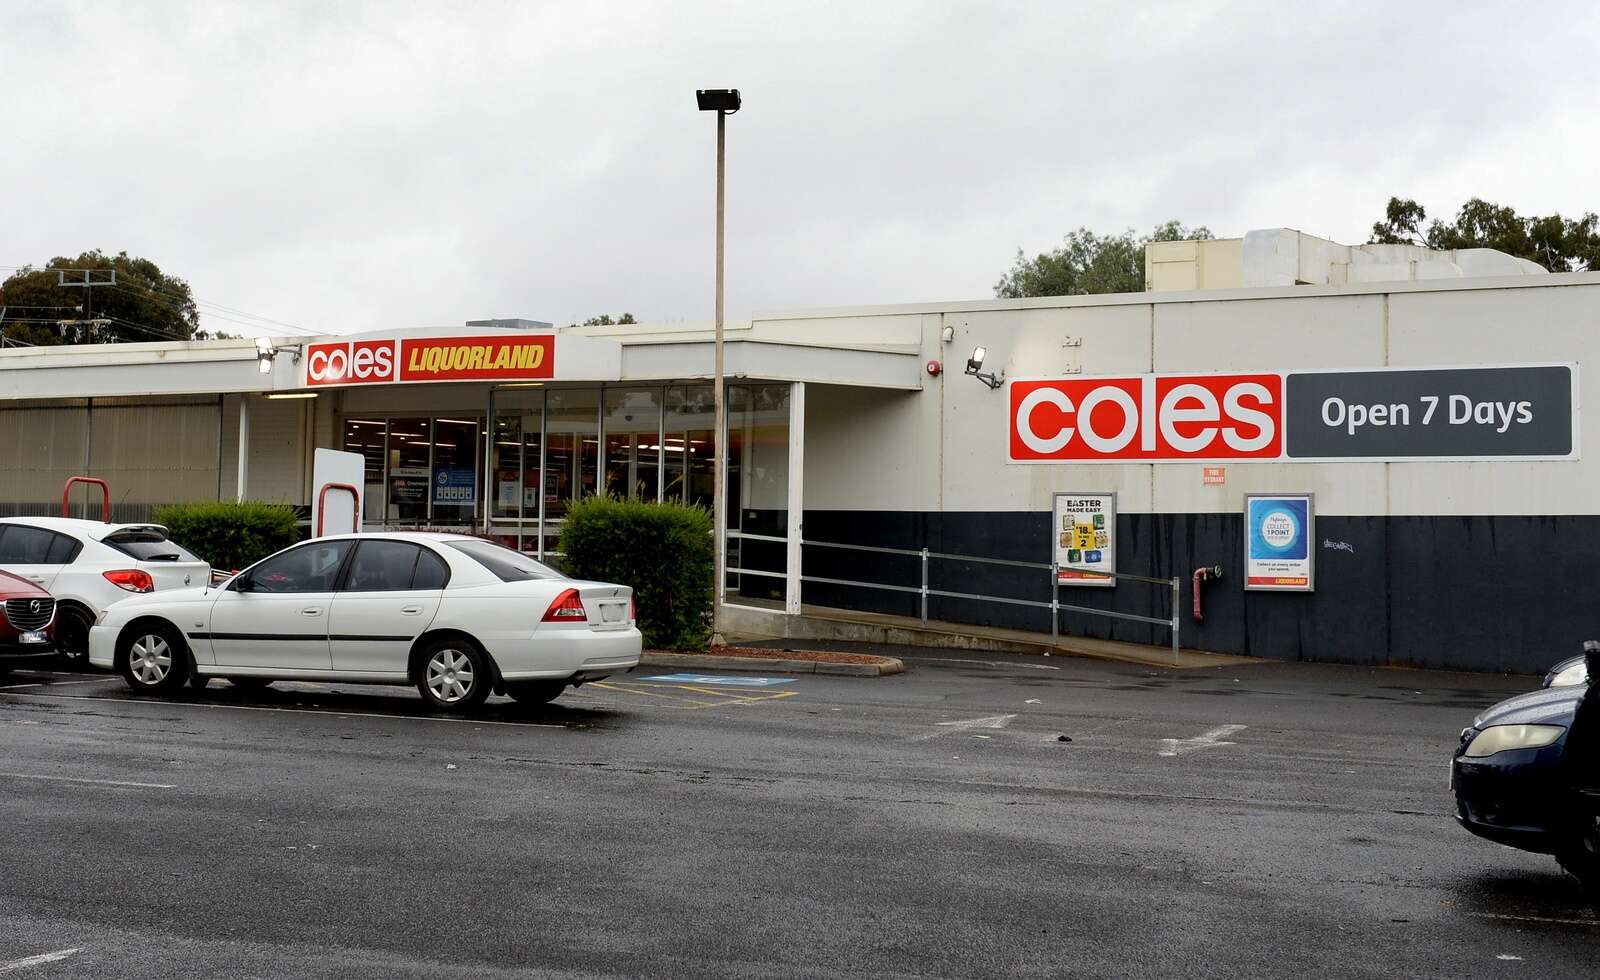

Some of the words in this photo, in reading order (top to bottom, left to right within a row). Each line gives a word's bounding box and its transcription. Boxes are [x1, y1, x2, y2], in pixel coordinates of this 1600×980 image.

[309, 342, 393, 380] coles
[408, 345, 545, 373] LIQUORLAND
[1016, 378, 1275, 453] coles
[1321, 397, 1410, 435] Open
[1420, 396, 1439, 424] 7
[1449, 394, 1533, 433] Days
